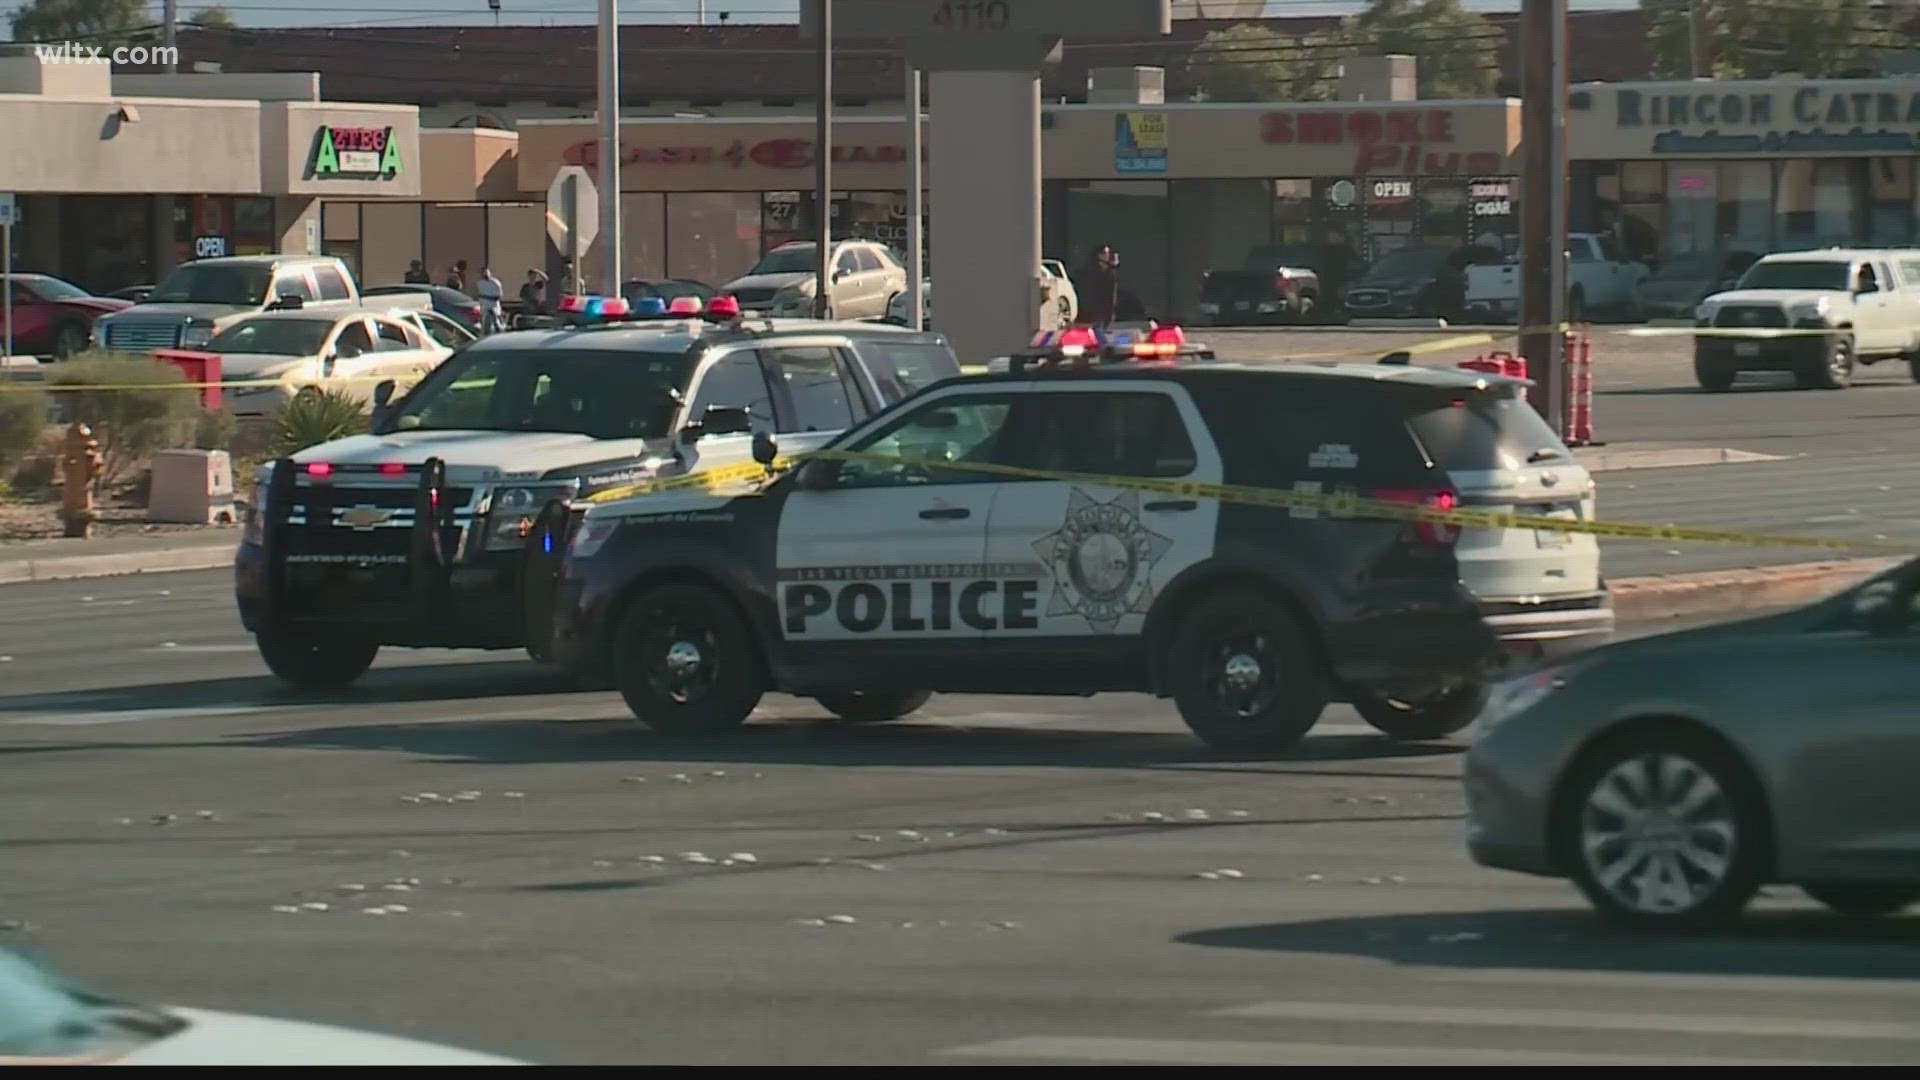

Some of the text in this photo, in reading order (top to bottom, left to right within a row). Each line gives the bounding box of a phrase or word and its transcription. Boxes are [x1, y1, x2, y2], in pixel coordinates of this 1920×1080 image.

[1616, 90, 1772, 126] RINCON
[1261, 110, 1455, 144] SMOKE
[315, 125, 405, 174] AZTECA
[1374, 181, 1412, 197] OPEN
[771, 203, 791, 219] 27
[1474, 201, 1511, 215] CIGAR
[195, 236, 225, 257] OPEN
[798, 569, 826, 580] LAS
[834, 567, 888, 579] VEGAS
[785, 579, 1039, 634] POLICE
